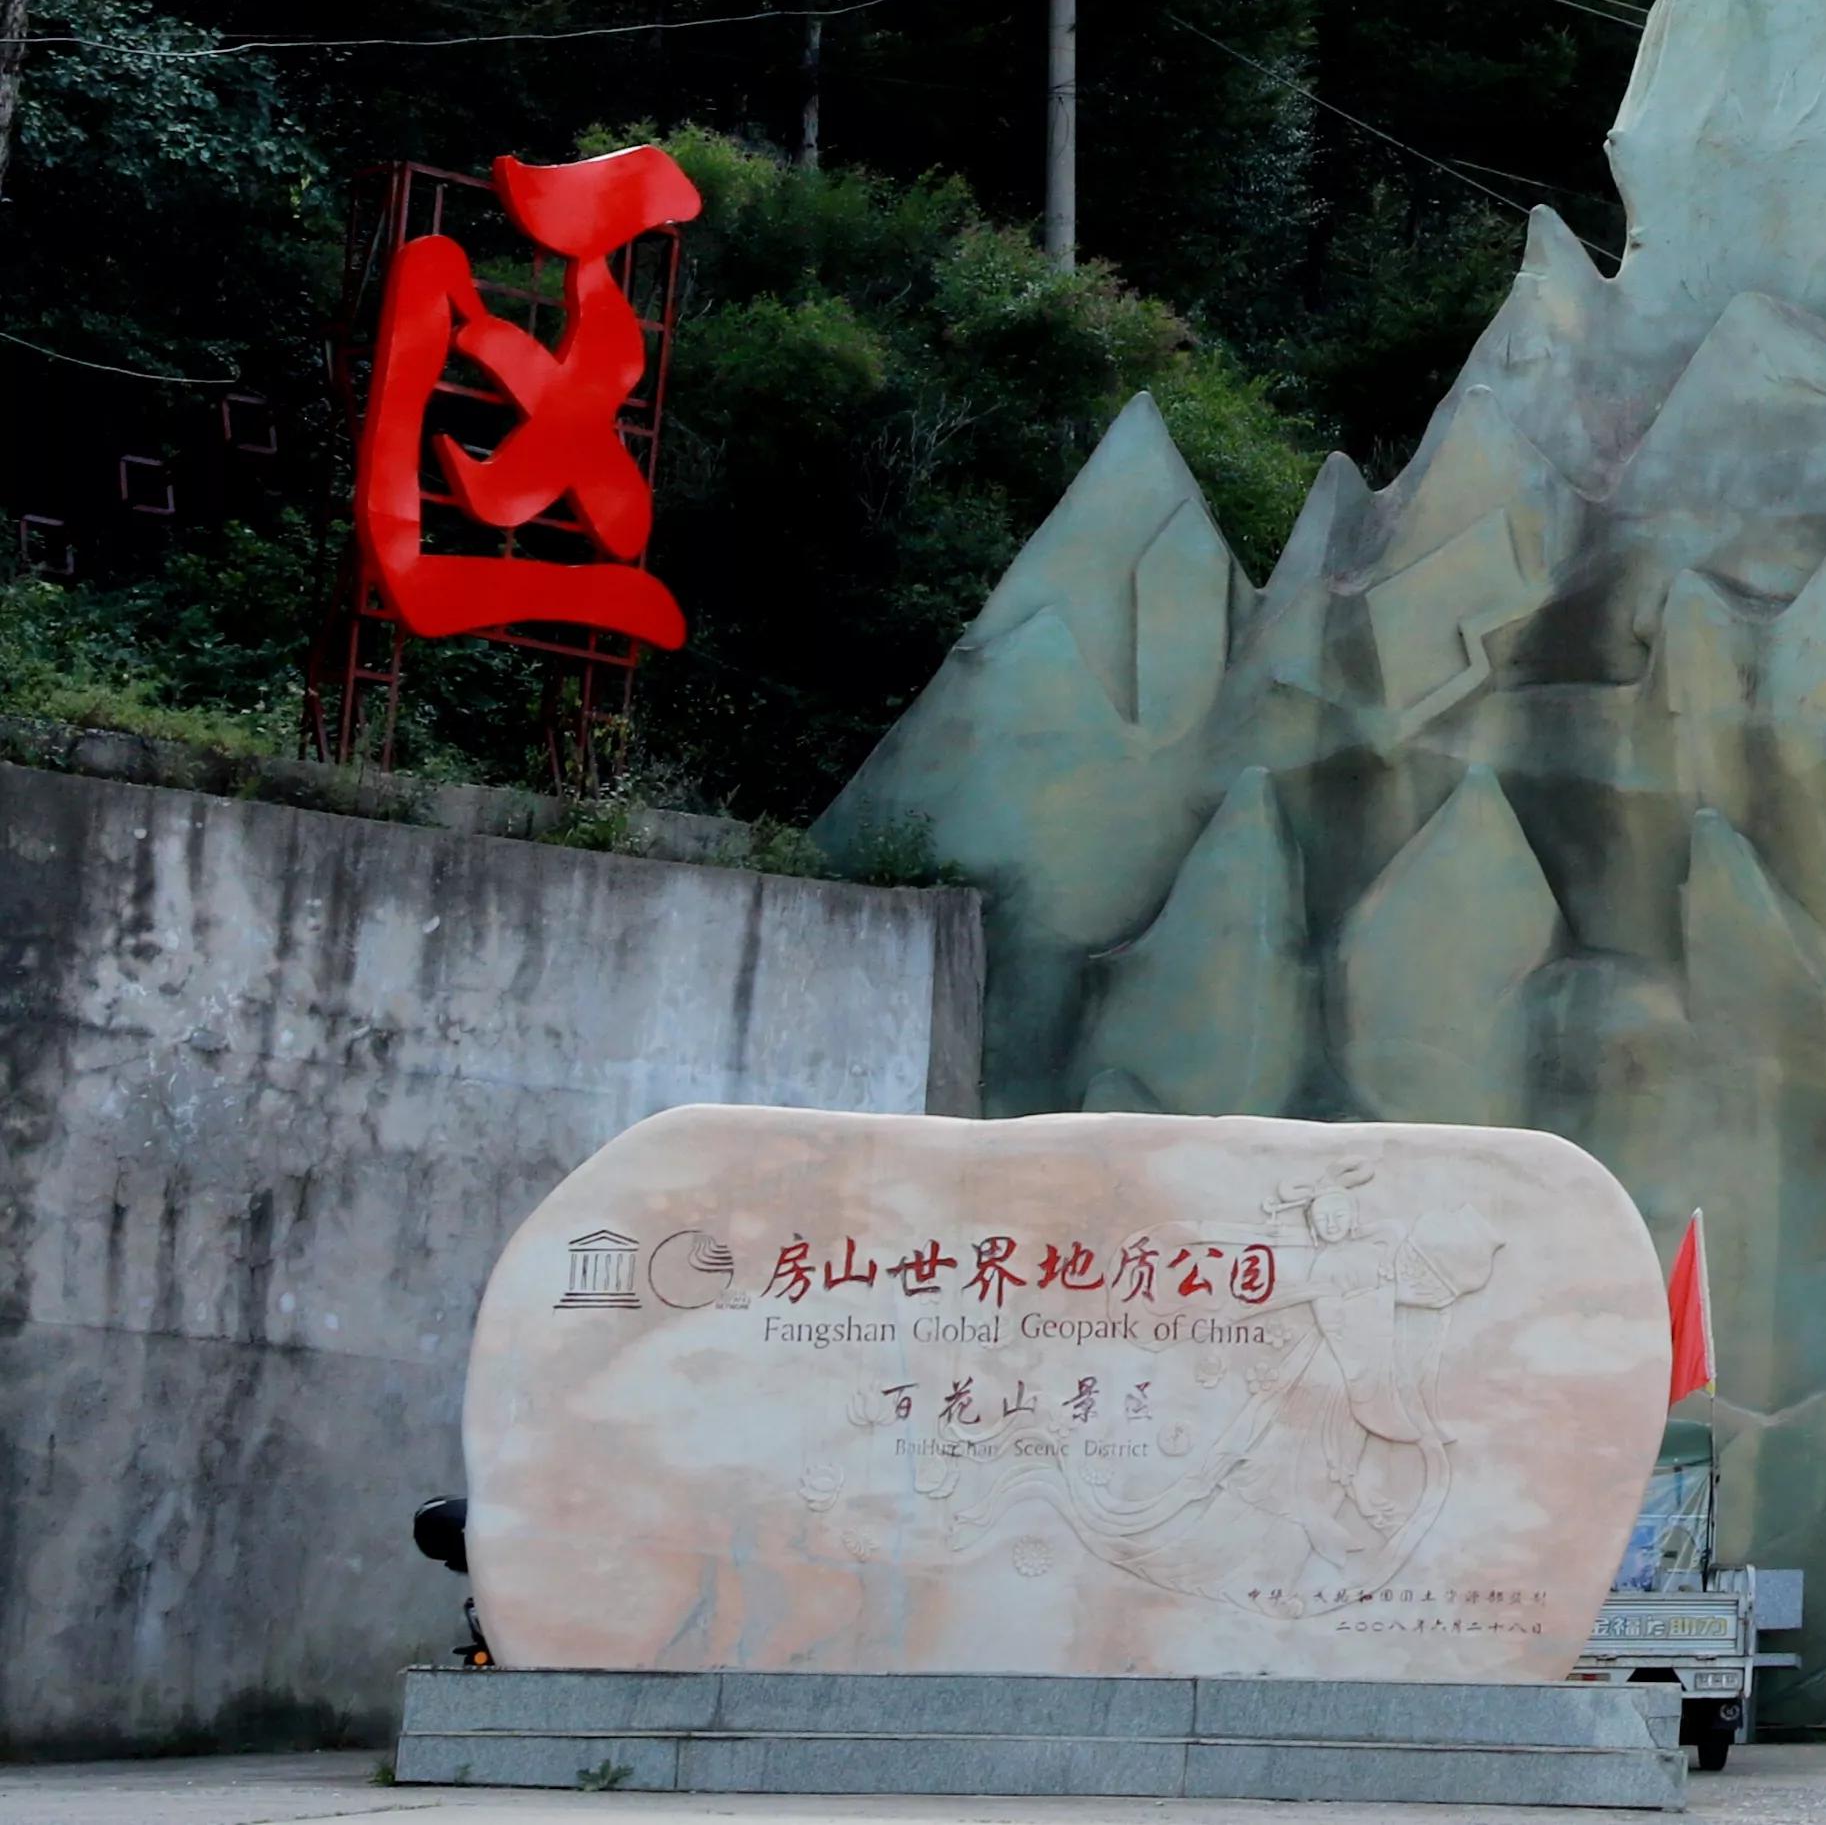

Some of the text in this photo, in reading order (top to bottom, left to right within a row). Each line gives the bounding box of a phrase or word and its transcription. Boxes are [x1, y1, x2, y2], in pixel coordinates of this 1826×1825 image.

[760, 1233, 1276, 1308] 房山世界地质公园
[764, 1312, 1266, 1349] Fangshan Global Geopark of China
[881, 1376, 1153, 1425] 百花山景区
[1014, 1438, 1069, 1457] Scenic
[1084, 1438, 1149, 1458] District
